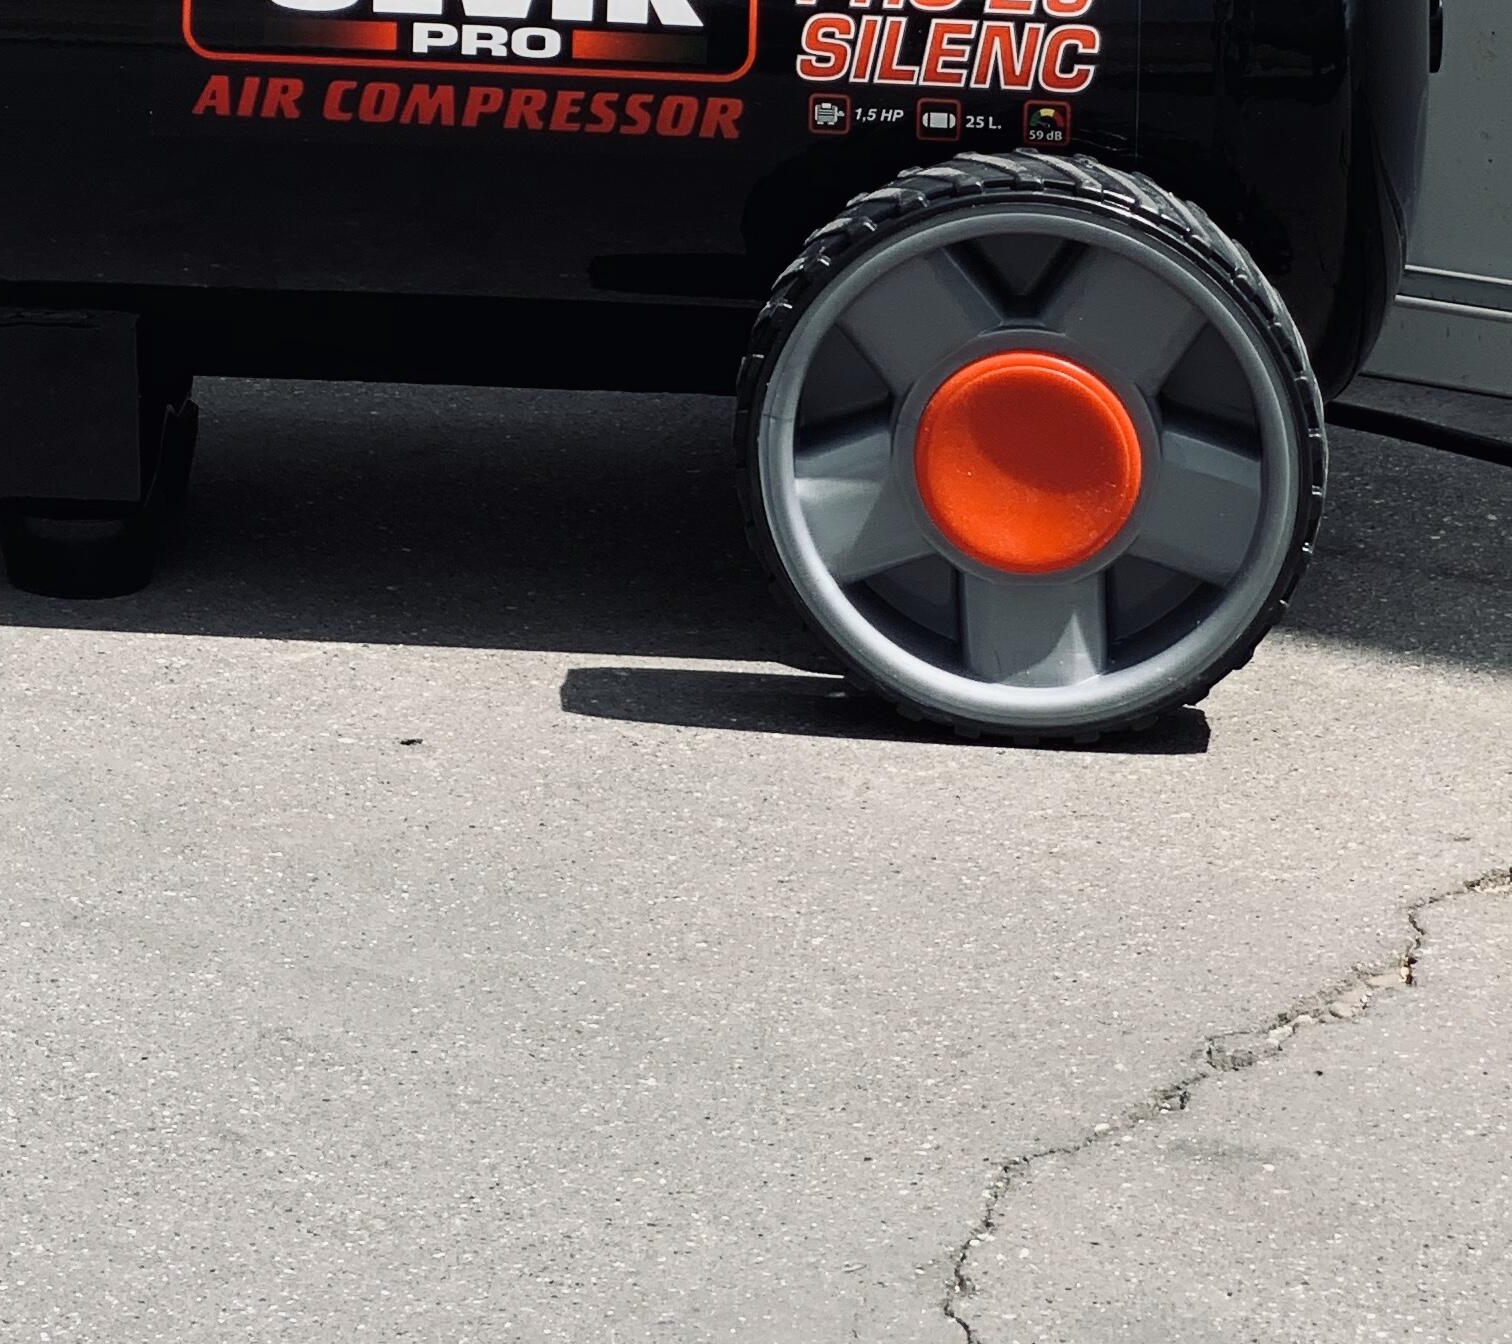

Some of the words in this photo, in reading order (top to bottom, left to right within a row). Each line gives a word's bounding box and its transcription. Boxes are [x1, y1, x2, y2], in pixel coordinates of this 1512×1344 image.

[411, 21, 563, 59] PRO
[795, 13, 1101, 93] SILENC
[191, 74, 306, 119] AIR
[321, 79, 745, 140] COMPRESSOR
[854, 108, 877, 122] 1,5
[880, 108, 904, 122] HP
[964, 115, 985, 129] 25
[988, 117, 1002, 130] L.
[1028, 129, 1044, 141] 59
[1046, 130, 1063, 142] dB
